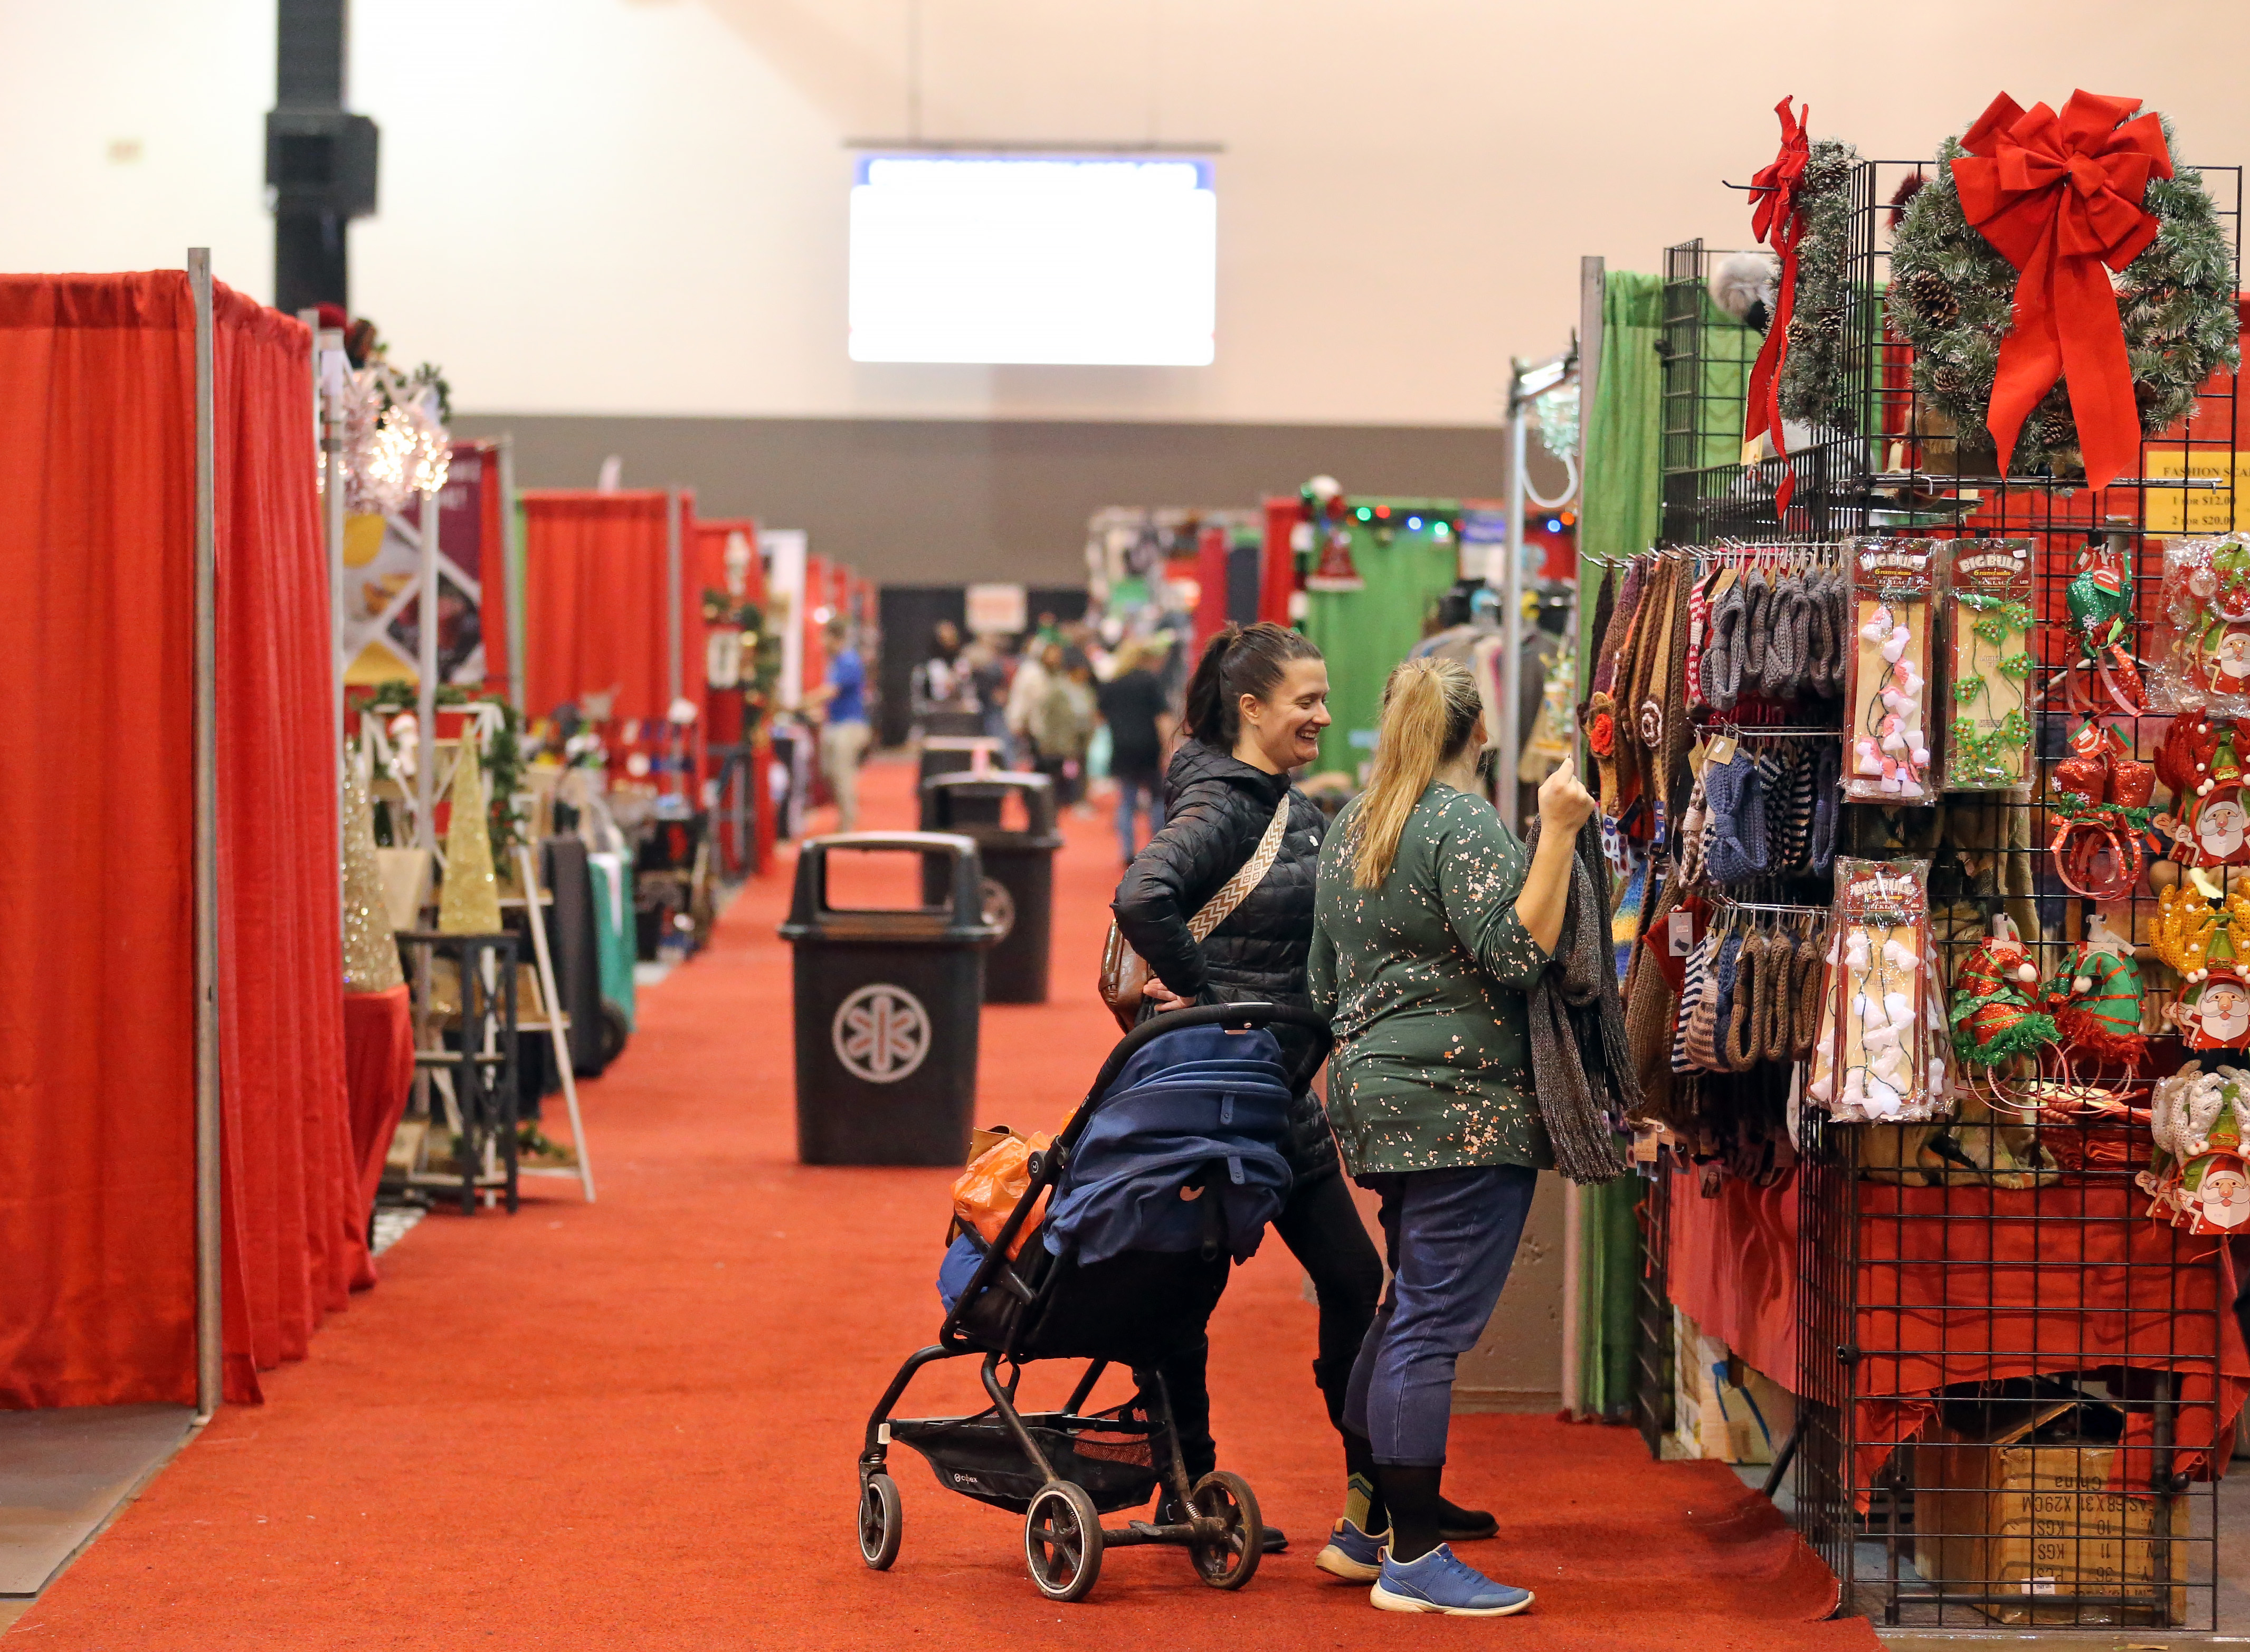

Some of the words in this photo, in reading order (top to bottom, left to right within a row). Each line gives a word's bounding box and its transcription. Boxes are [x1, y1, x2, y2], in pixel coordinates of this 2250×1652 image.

[2163, 467, 2219, 477] FASHION
[2223, 467, 2250, 477] SCA
[2173, 496, 2177, 505] 1
[2202, 496, 2235, 505] $12.0
[2172, 516, 2177, 525] 2
[2201, 516, 2235, 525] $20.0
[1958, 554, 1985, 573] BIG
[1985, 554, 2025, 573] BULB
[1852, 879, 1878, 897] BIG
[2055, 1476, 2102, 1490] Chna
[2036, 1520, 2064, 1536] KGS
[2097, 1520, 2111, 1535] 10
[2037, 1543, 2065, 1560] KGS
[2101, 1543, 2111, 1559] 11
[2096, 1566, 2113, 1582] 36
